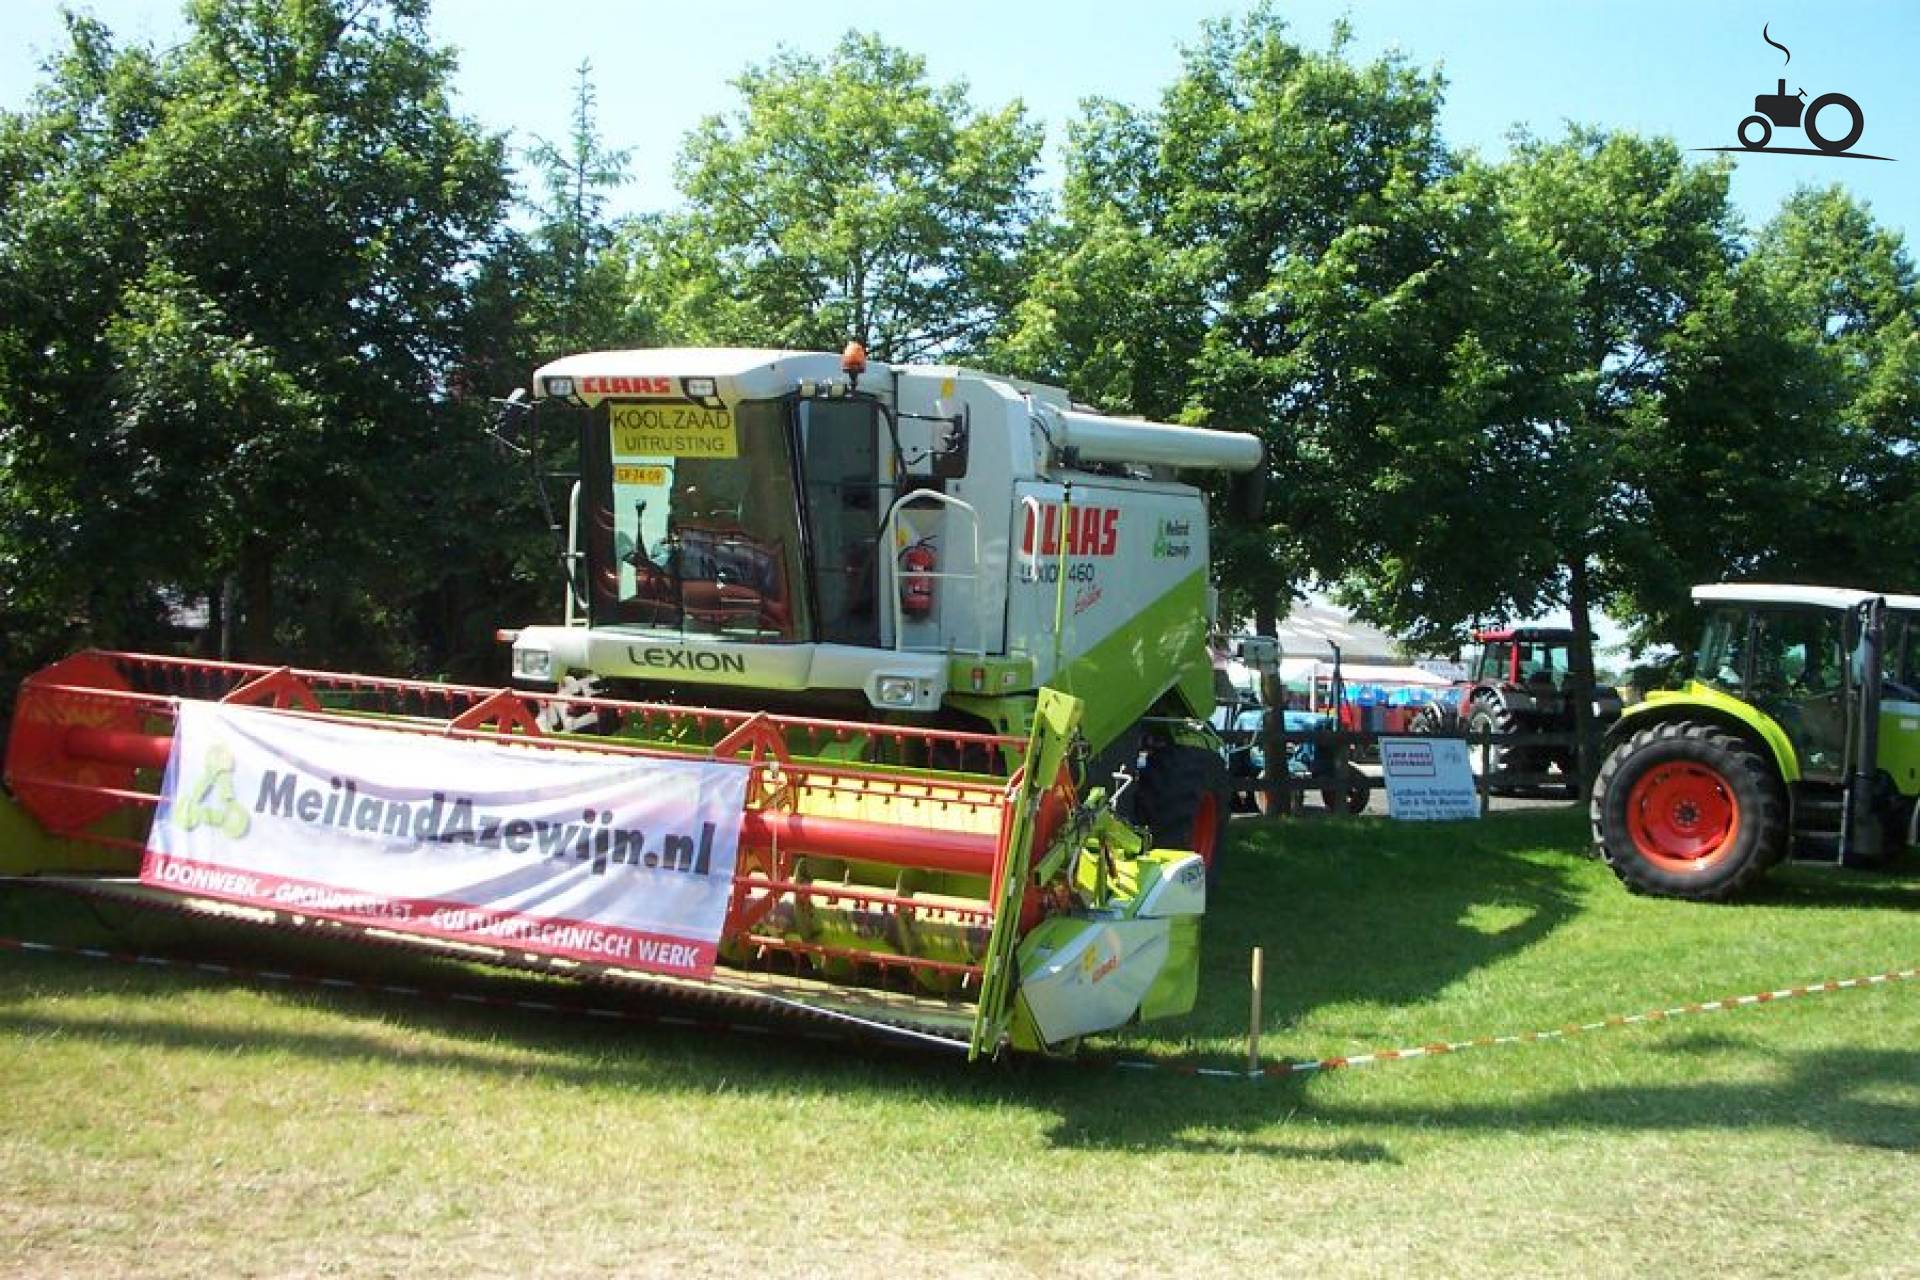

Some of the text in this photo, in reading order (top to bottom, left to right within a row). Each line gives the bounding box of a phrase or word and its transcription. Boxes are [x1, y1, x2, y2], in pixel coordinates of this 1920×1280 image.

[583, 377, 671, 394] CLAAS
[613, 408, 731, 431] KOOLZAAD
[624, 436, 725, 452] UITRUSTING
[1068, 562, 1095, 583] 460
[628, 646, 745, 673] LEXION
[255, 769, 716, 876] MeilandAzewijn.nl
[154, 858, 260, 898] LOONWERK
[639, 937, 700, 968] WERK
